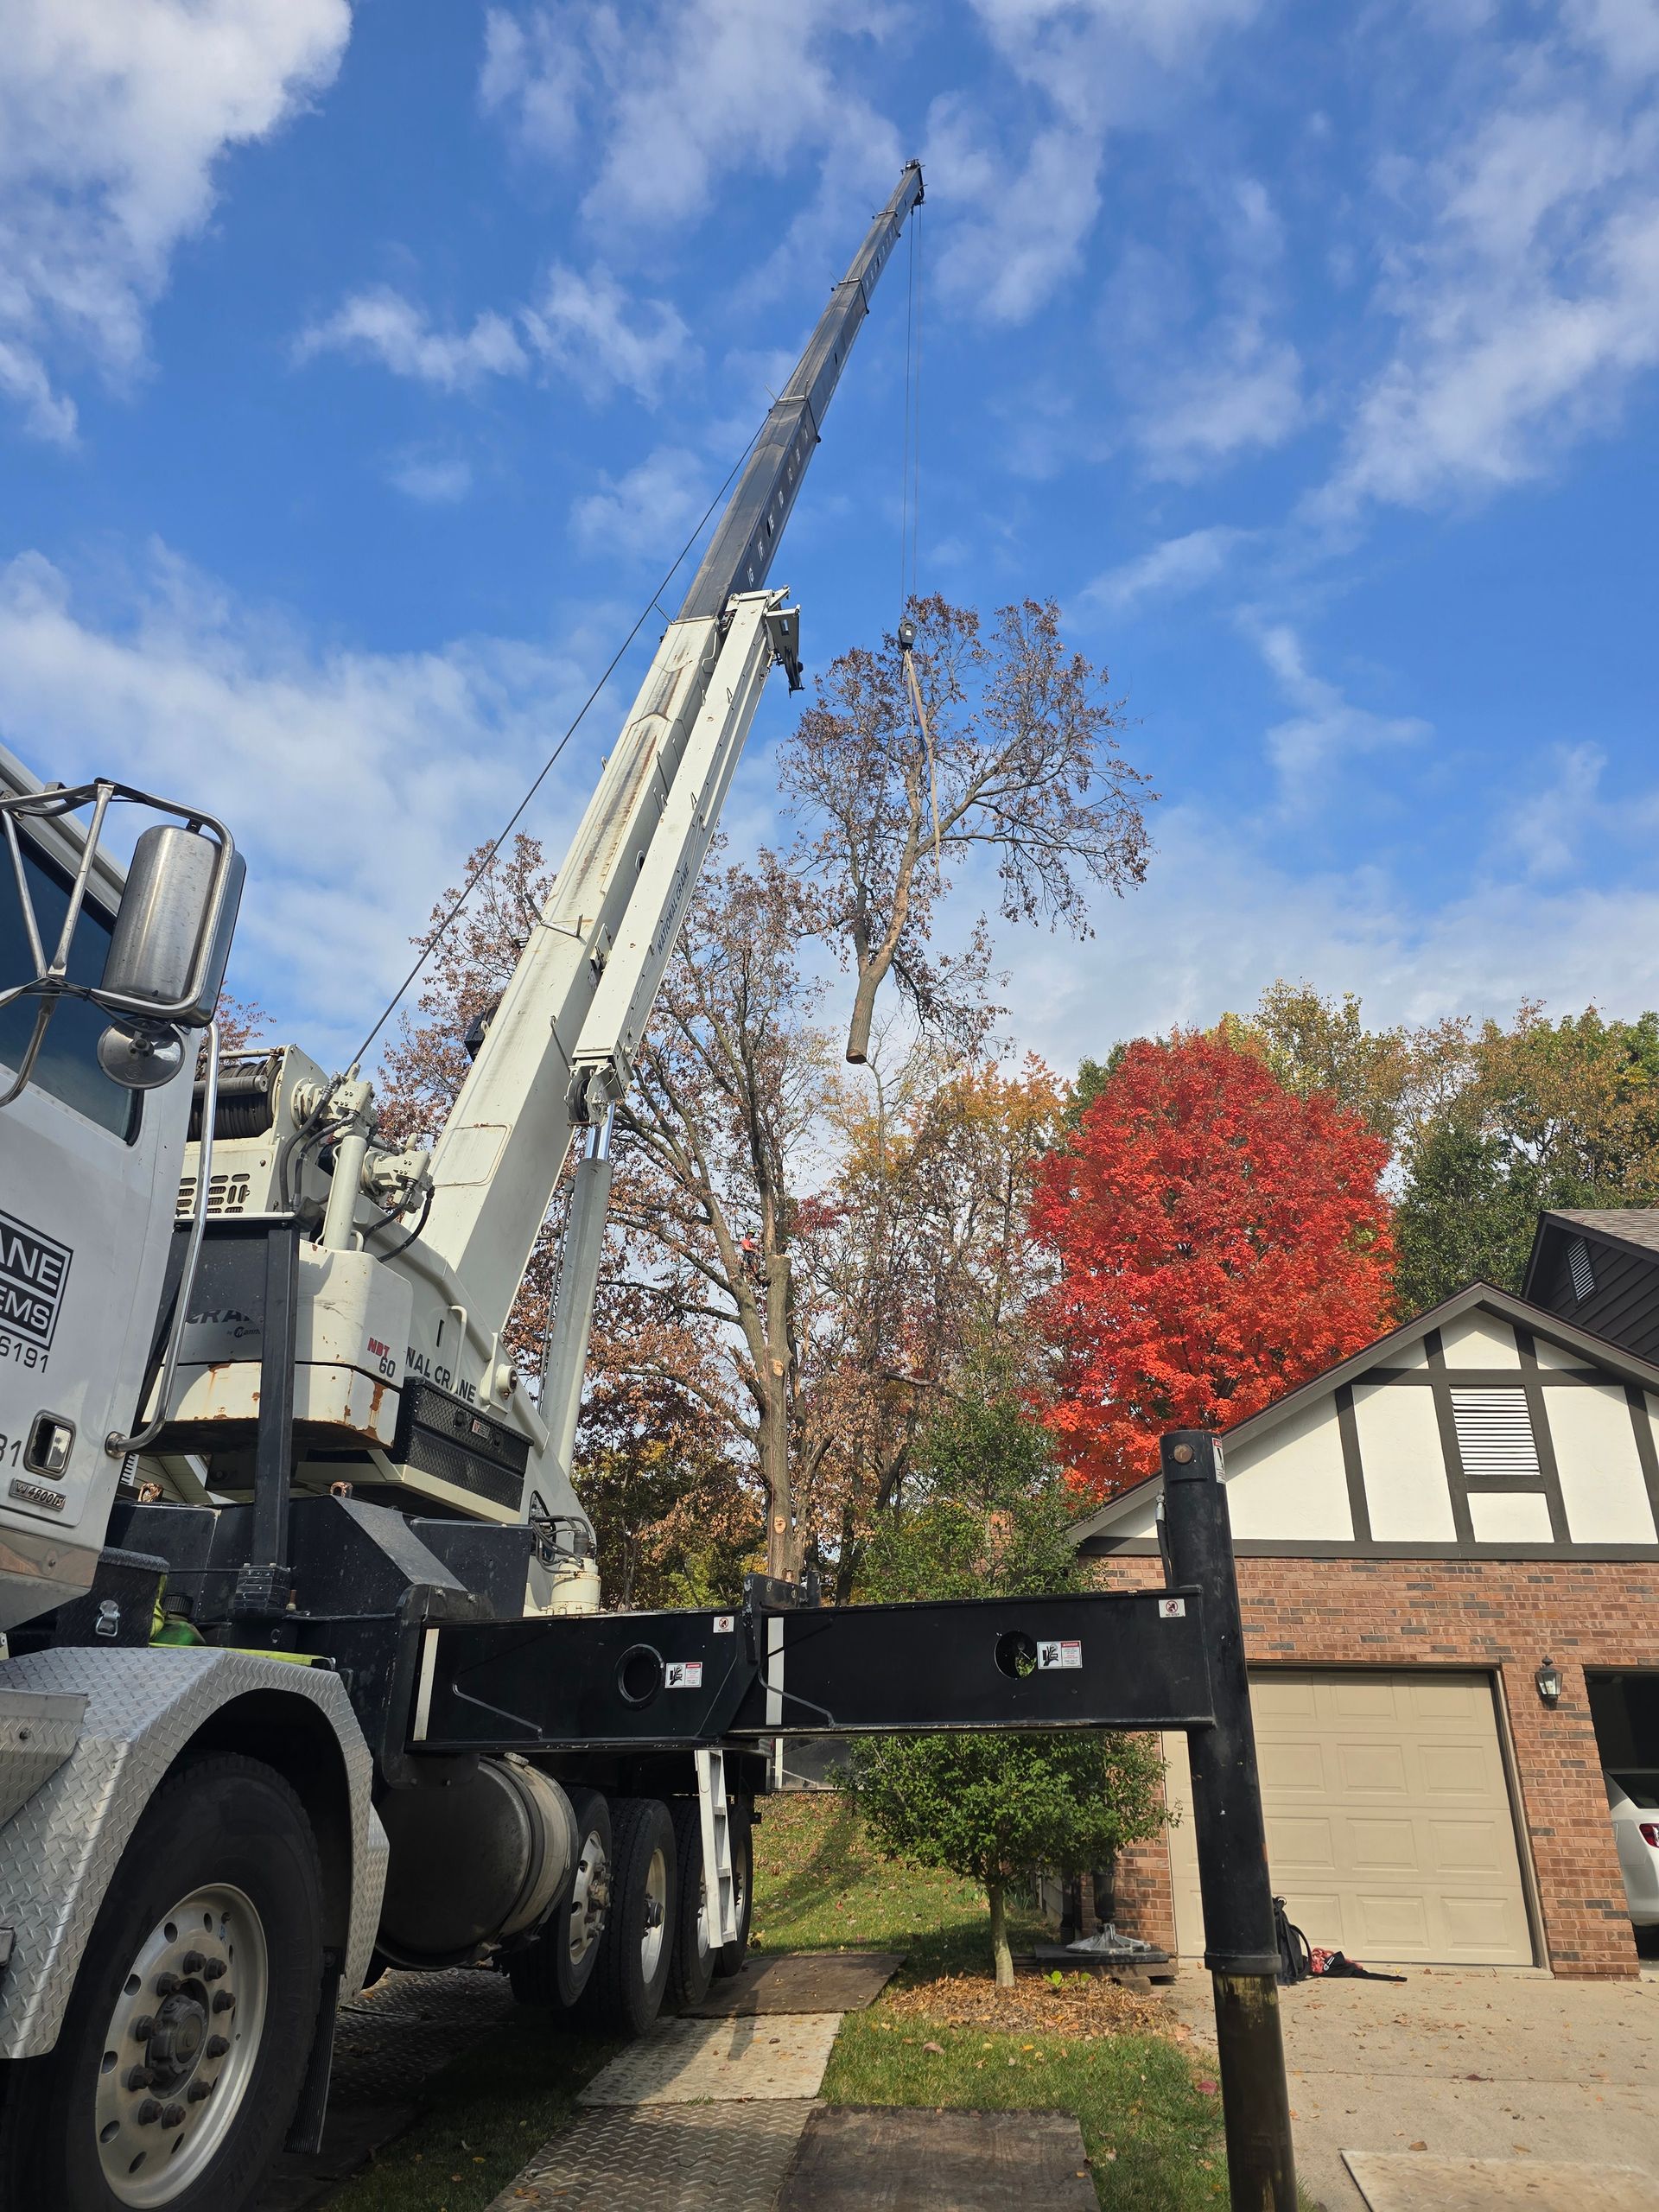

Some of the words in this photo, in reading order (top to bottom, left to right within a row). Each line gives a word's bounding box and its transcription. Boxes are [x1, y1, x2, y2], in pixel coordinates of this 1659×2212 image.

[658, 899, 678, 954] NATIONAL
[677, 862, 690, 900] CRANE
[367, 1337, 391, 1359] NBT
[378, 1357, 396, 1378] 60
[406, 1346, 430, 1378] NAL
[435, 1366, 477, 1403] CRNE
